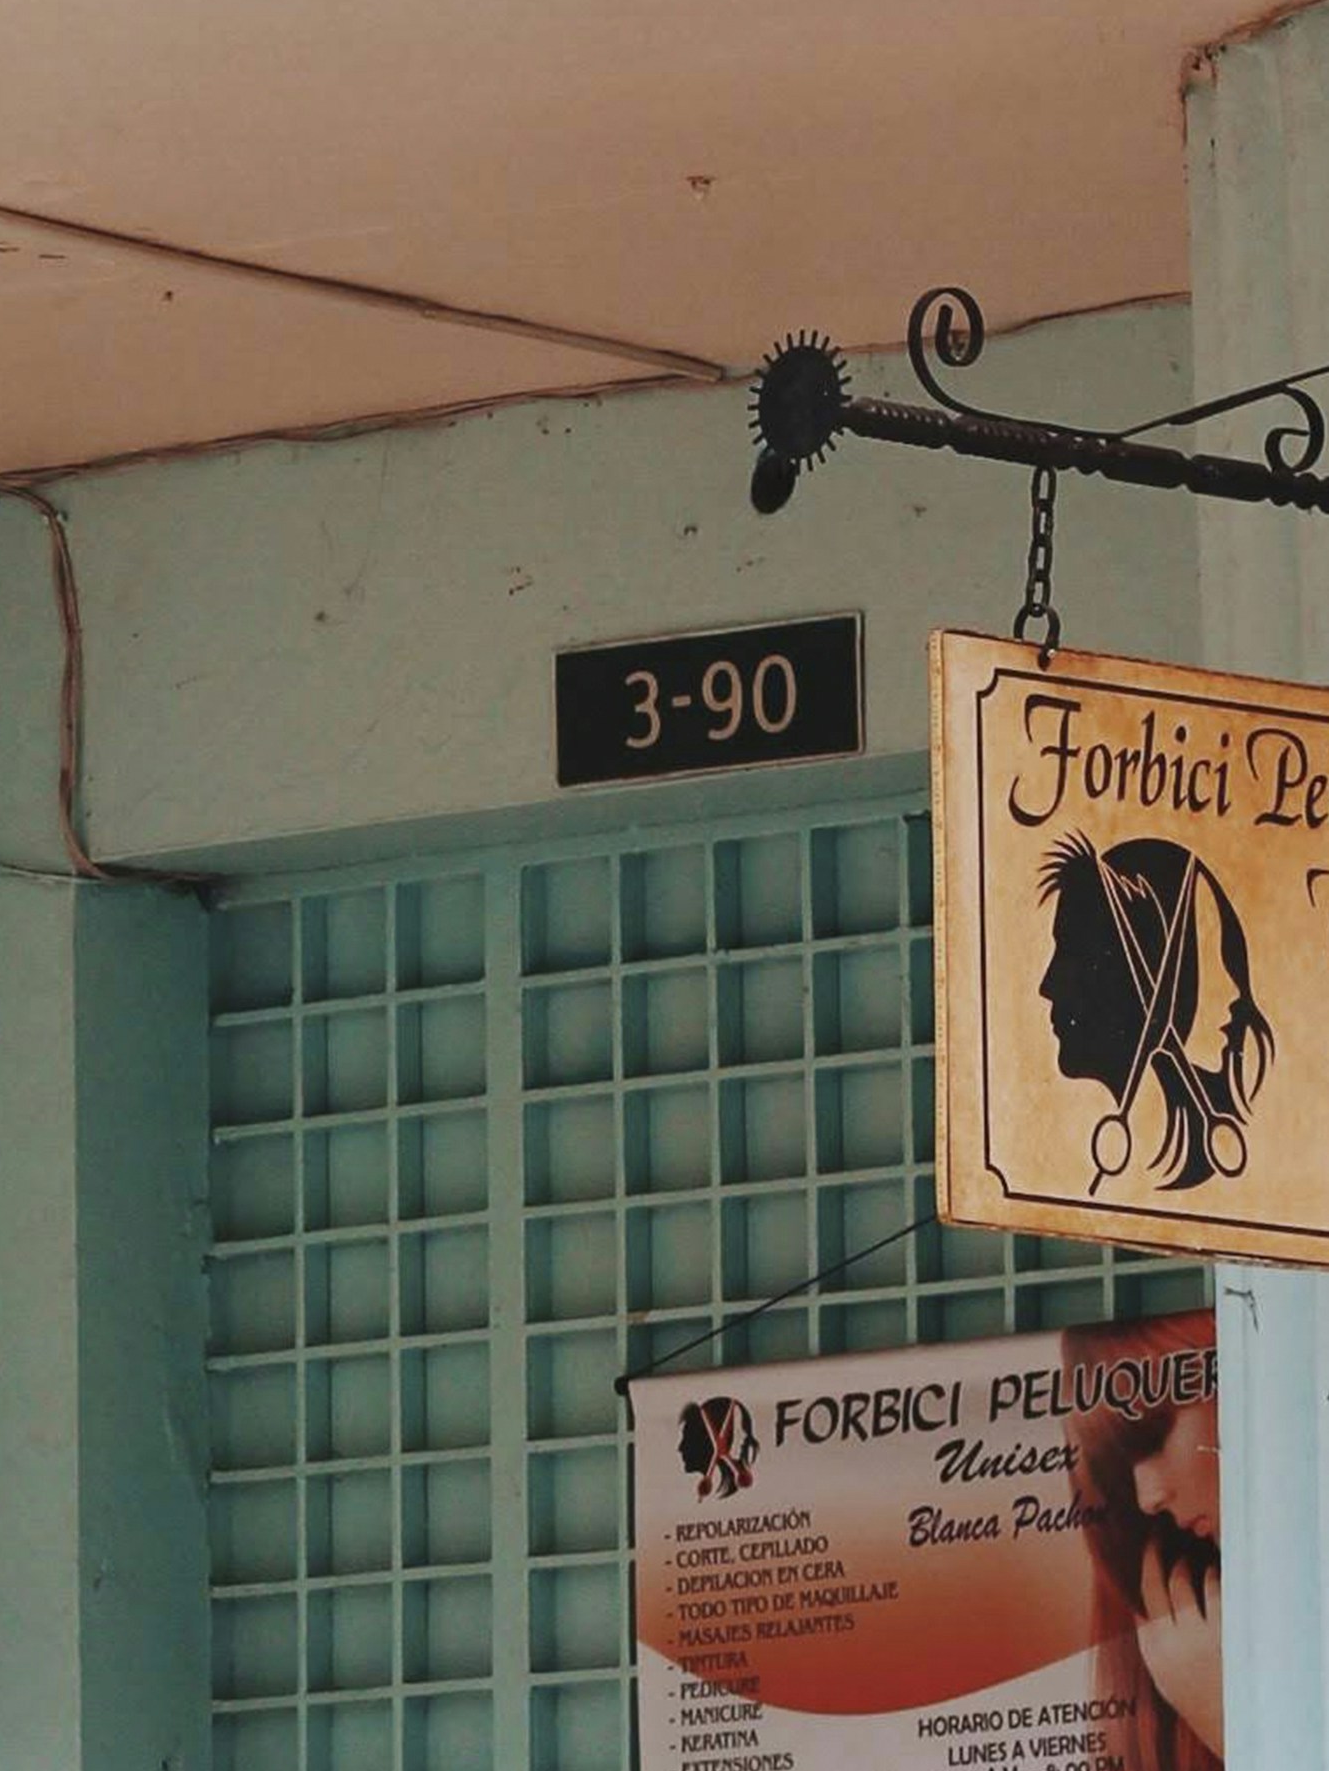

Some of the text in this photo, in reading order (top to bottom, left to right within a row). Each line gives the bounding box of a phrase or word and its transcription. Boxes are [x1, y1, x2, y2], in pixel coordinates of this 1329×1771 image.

[625, 654, 796, 749] 3-90
[1008, 694, 1231, 827] Forbici
[776, 1381, 962, 1447] FORBICI
[934, 1438, 1079, 1483] Unisex
[676, 1507, 811, 1542] REPOLARIZACIÓN
[908, 1505, 1001, 1547] Blanca
[739, 1536, 829, 1562] CEPILLADO
[778, 1566, 798, 1584] EN
[803, 1560, 845, 1579] CERA
[679, 1581, 899, 1621] TODO TIPO DE MAQUILLAJE
[679, 1614, 855, 1647] MASAJES RELAJANTES
[679, 1651, 748, 1673] TINTURA
[680, 1676, 760, 1700] PEDICURE
[681, 1703, 763, 1726] MANICURE
[918, 1696, 1136, 1738] HORARIO DE ATENCIÓN
[681, 1729, 759, 1753] KERATINA
[948, 1732, 1107, 1766] LUNES A VIERNES
